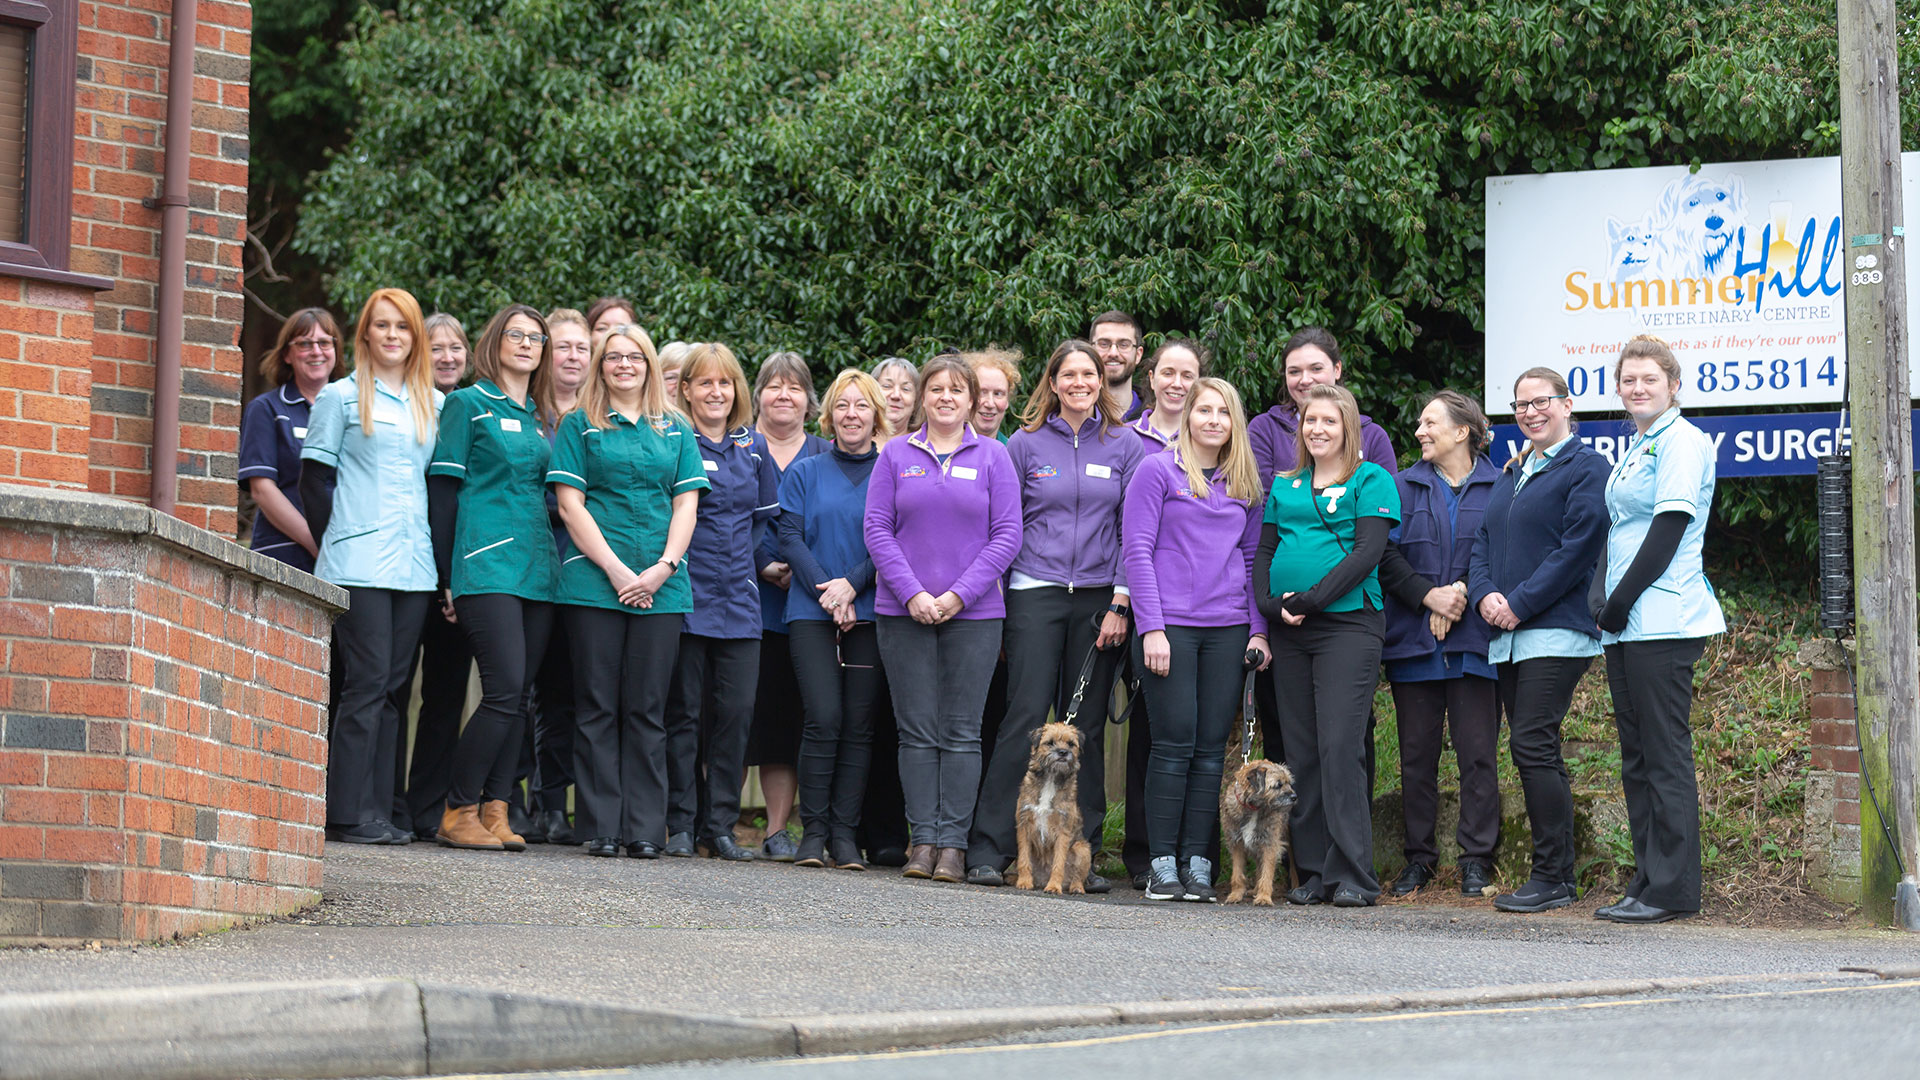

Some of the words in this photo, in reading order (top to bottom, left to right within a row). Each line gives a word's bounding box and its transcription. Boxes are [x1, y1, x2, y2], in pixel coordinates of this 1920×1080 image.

[1853, 272, 1880, 284] 389
[1641, 308, 1752, 327] VETERINARY
[1763, 305, 1831, 322] CENTRE
[1561, 343, 1586, 355] "we
[1590, 341, 1621, 354] treat
[1670, 339, 1689, 350] ets
[1693, 340, 1708, 350] as
[1712, 335, 1724, 349] if
[1778, 335, 1803, 346] our
[1806, 331, 1843, 345] own"
[1696, 355, 1839, 393] 855814
[1734, 427, 1852, 463] SURGE
